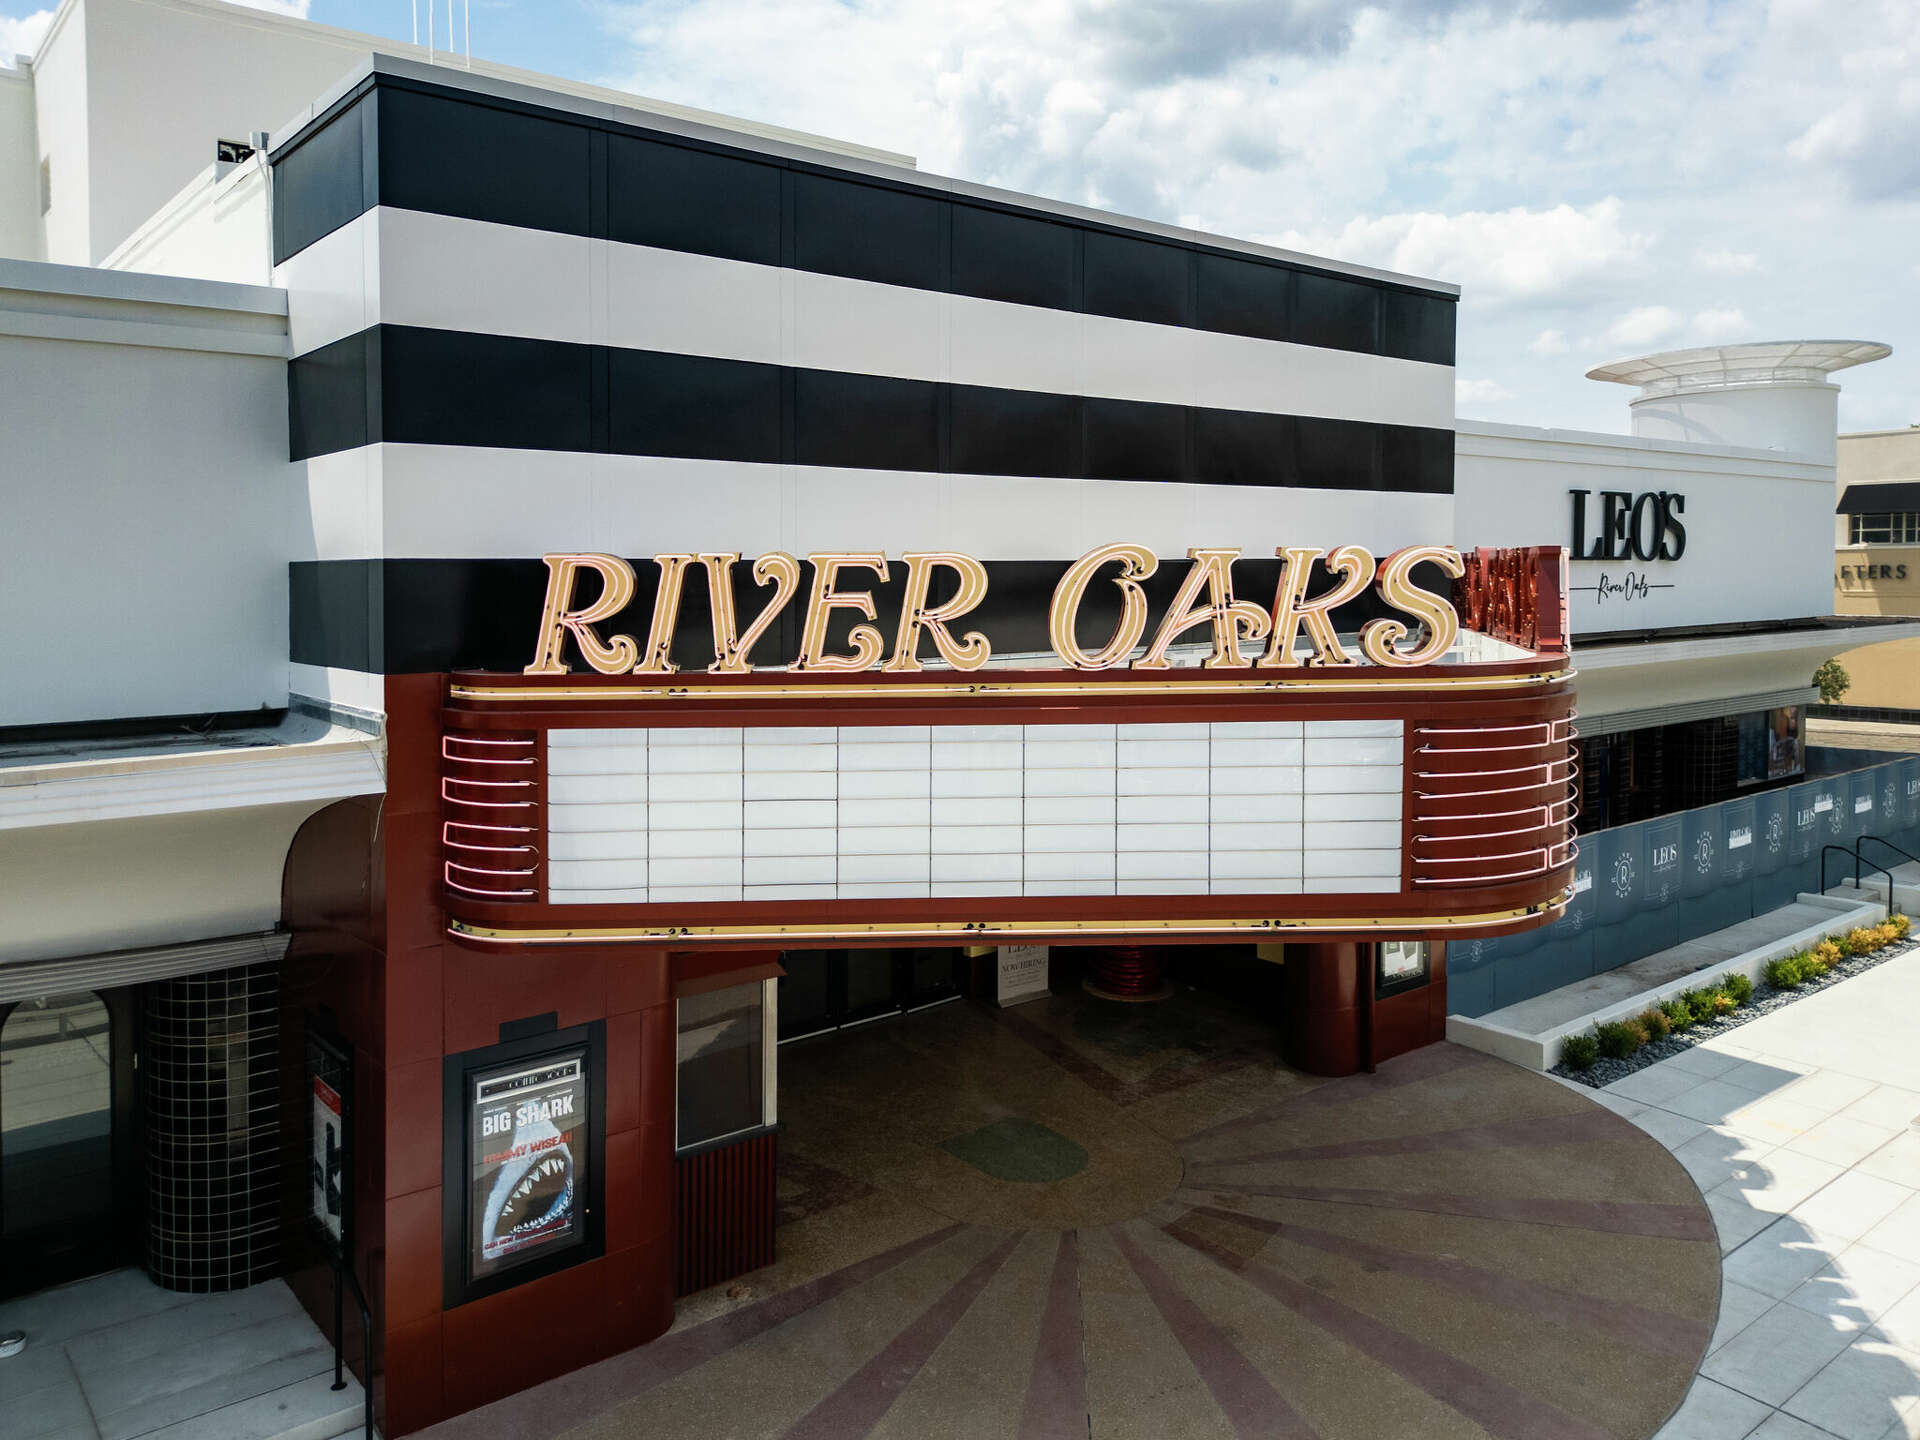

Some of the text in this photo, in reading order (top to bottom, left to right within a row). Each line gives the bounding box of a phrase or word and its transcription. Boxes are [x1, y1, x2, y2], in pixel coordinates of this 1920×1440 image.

[1568, 489, 1687, 562] LEO'S
[1597, 572, 1625, 604] River
[1835, 564, 1907, 580] FTERS
[522, 542, 1467, 676] RIVER OAKS
[483, 1094, 574, 1137] BIG SHARK
